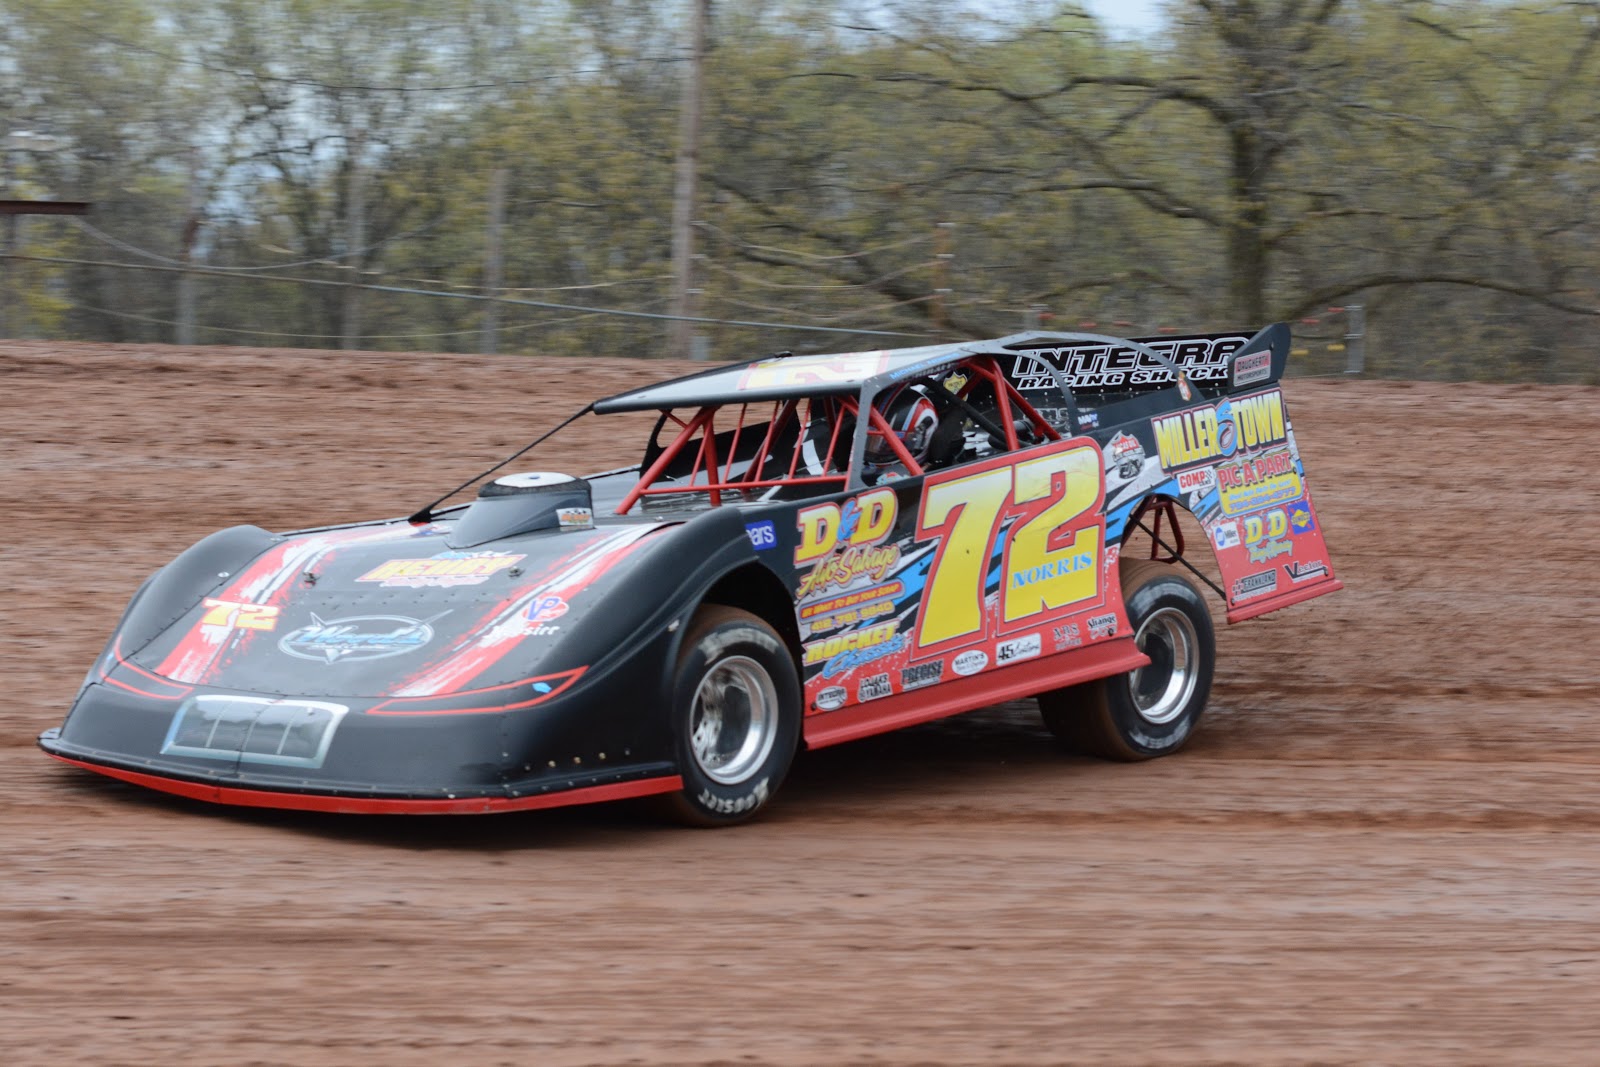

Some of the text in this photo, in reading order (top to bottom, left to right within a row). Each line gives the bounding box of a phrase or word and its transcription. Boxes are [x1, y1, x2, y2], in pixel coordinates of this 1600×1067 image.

[889, 363, 925, 379] MICHAEL
[1012, 336, 1249, 378] INTEGRA
[1017, 371, 1125, 390] RACING
[1180, 470, 1205, 488] COMP
[1217, 452, 1292, 491] PIC A PART
[746, 525, 775, 546] ars
[795, 488, 897, 566] D&D
[917, 445, 1101, 648] 72
[834, 543, 899, 584] Salvage
[1011, 550, 1094, 590] NORRIS
[1283, 560, 1324, 580] Vector
[201, 599, 279, 632] 72
[526, 596, 560, 621] VP
[804, 620, 900, 663] ROCKET
[998, 643, 1014, 661] 45
